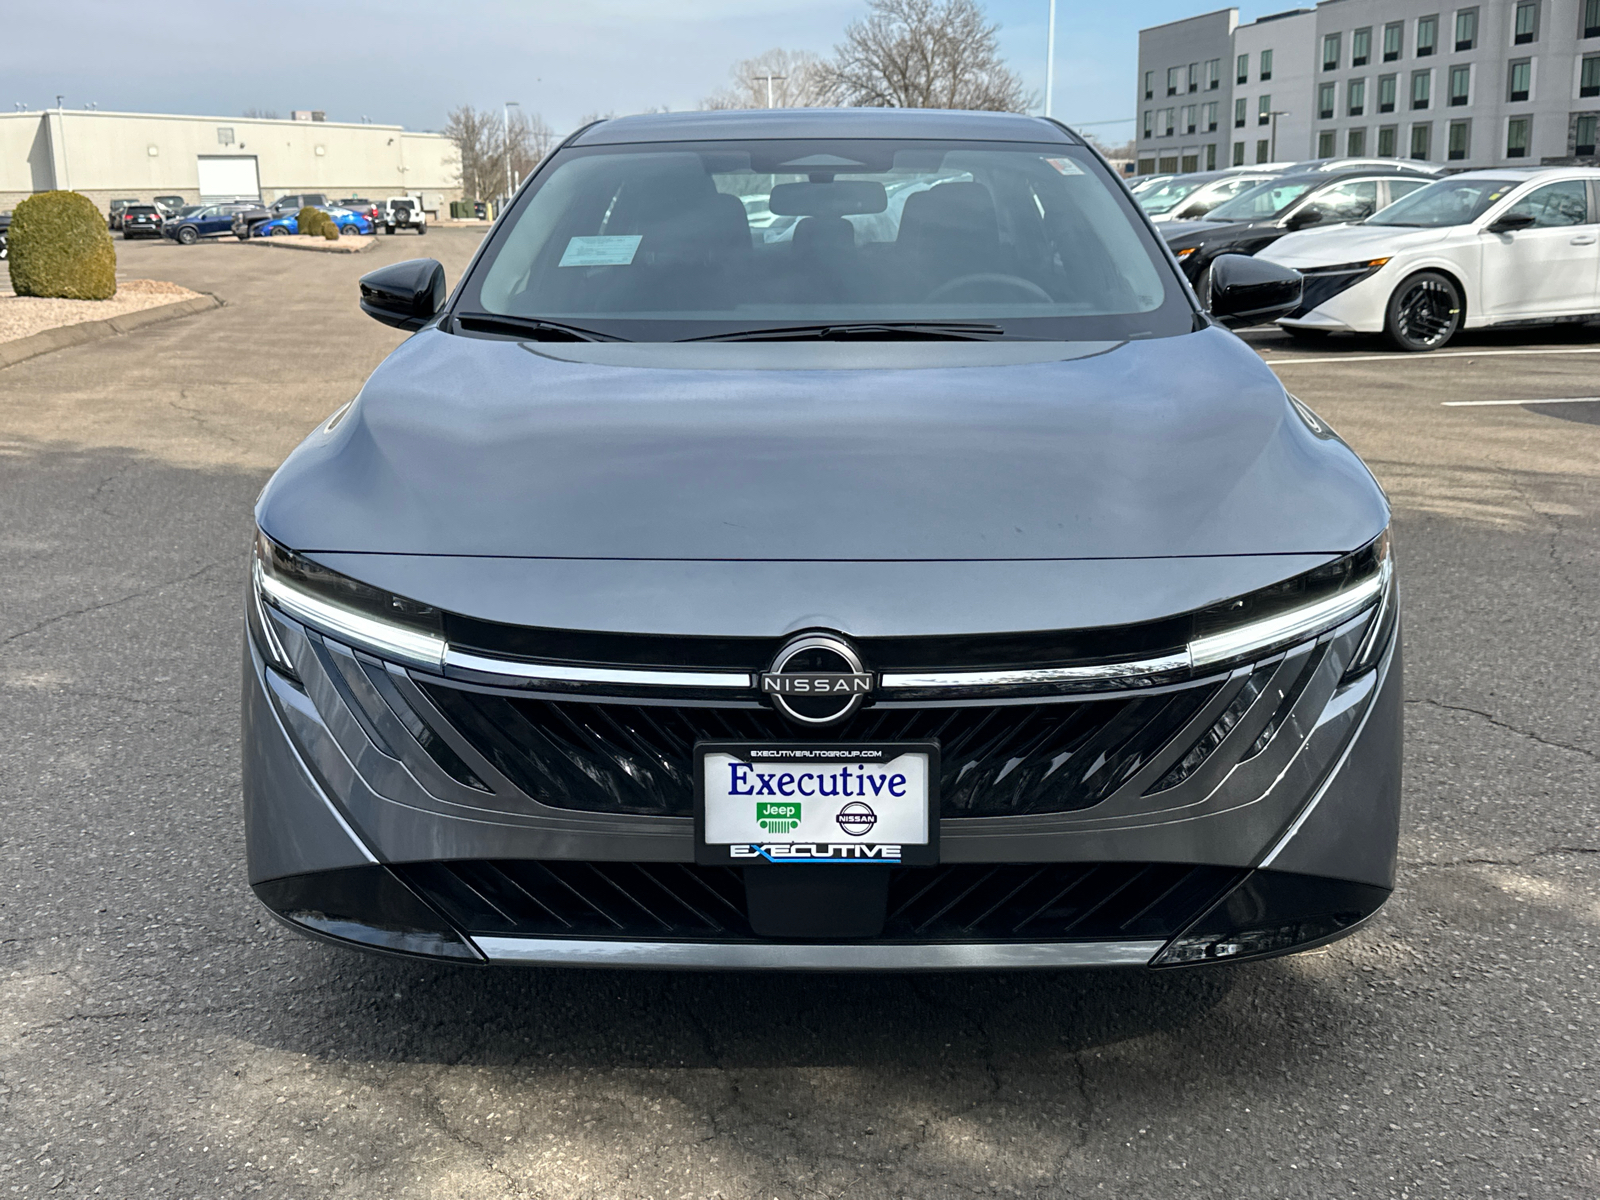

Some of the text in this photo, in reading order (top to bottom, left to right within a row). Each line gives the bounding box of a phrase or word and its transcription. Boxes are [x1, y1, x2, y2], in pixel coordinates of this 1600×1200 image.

[764, 676, 871, 692] NISSAN
[750, 750, 882, 758] EXECUTIVEAUTOGROUP.COM
[728, 762, 907, 797] Executive
[762, 804, 795, 818] Jeep
[730, 844, 902, 859] EXECUTIVE
